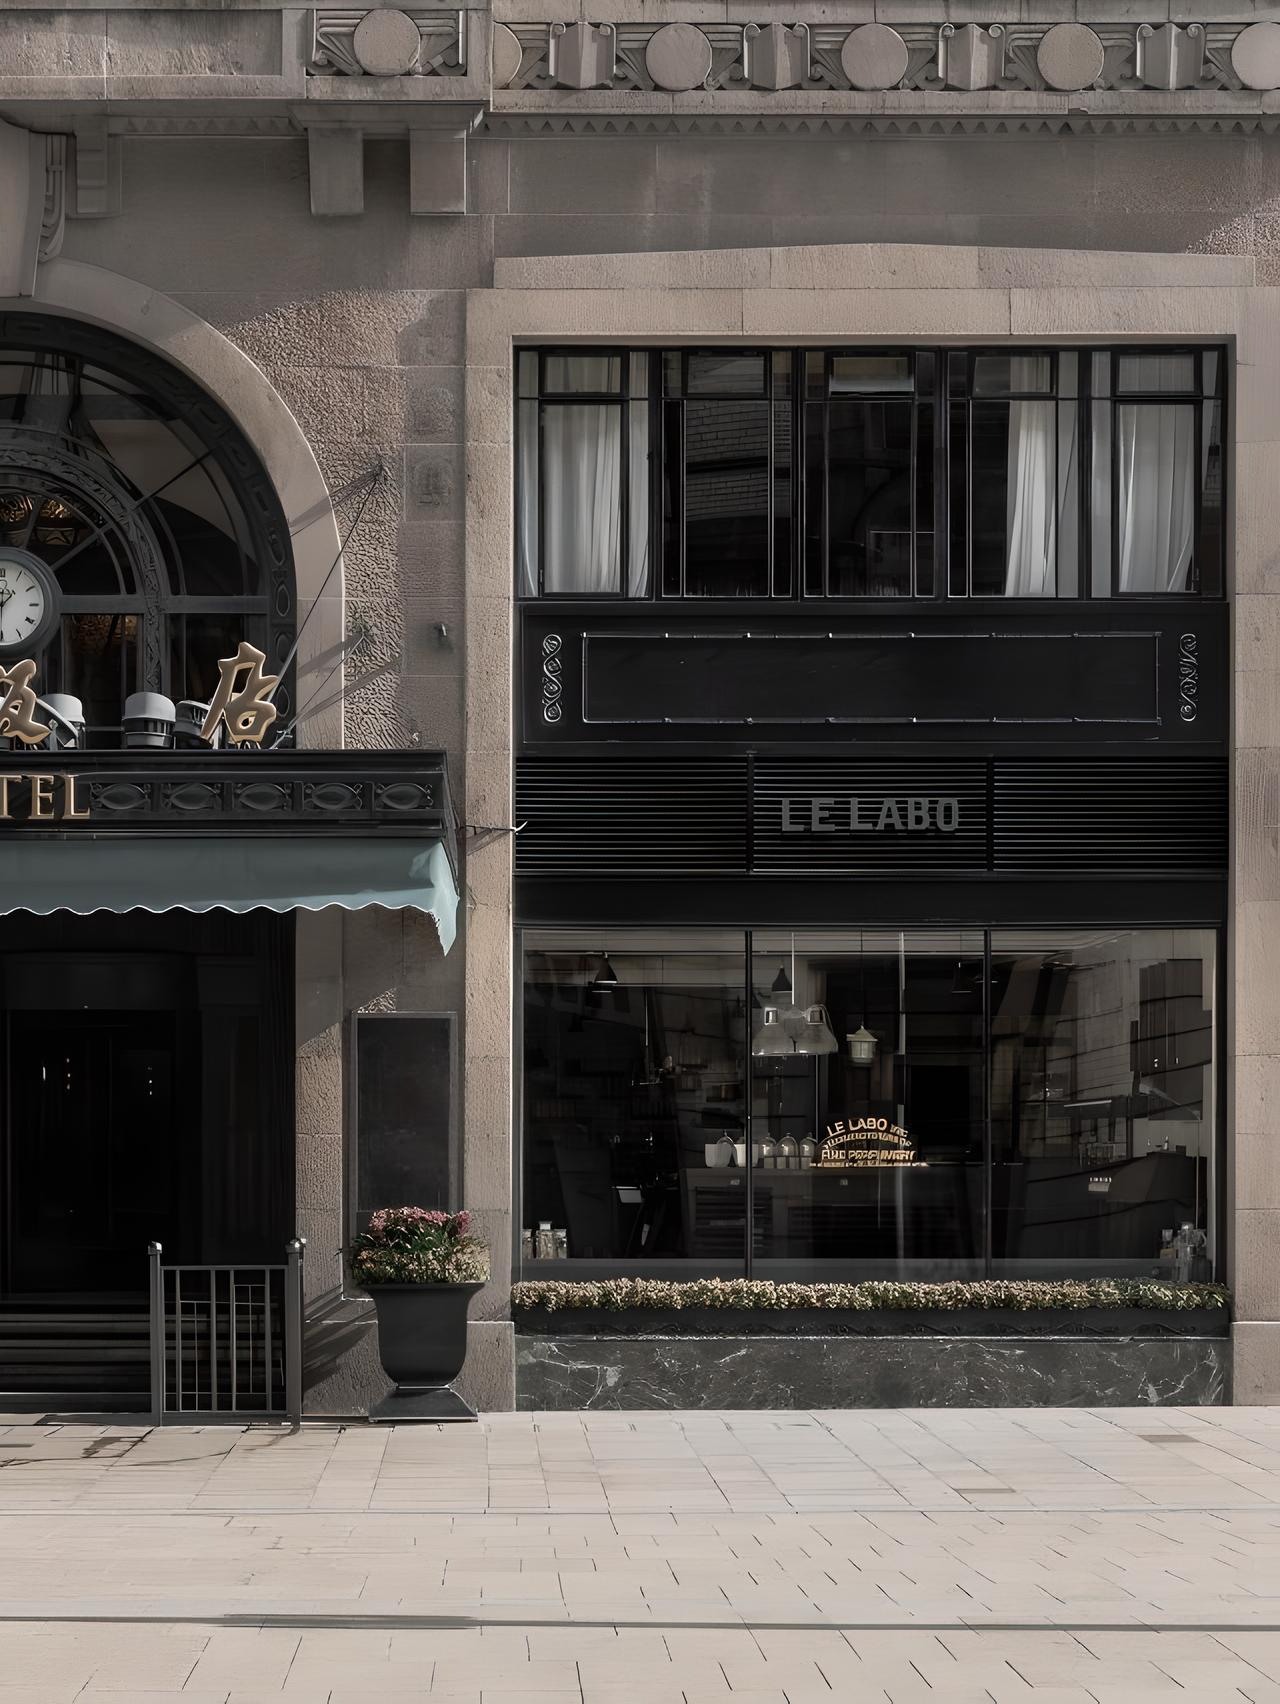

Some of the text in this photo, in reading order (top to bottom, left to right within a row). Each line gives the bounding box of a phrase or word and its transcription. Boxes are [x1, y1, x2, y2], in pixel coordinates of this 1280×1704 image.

[781, 798, 960, 831] LE LABO
[826, 1121, 846, 1137] LE
[848, 1117, 888, 1131] LABO
